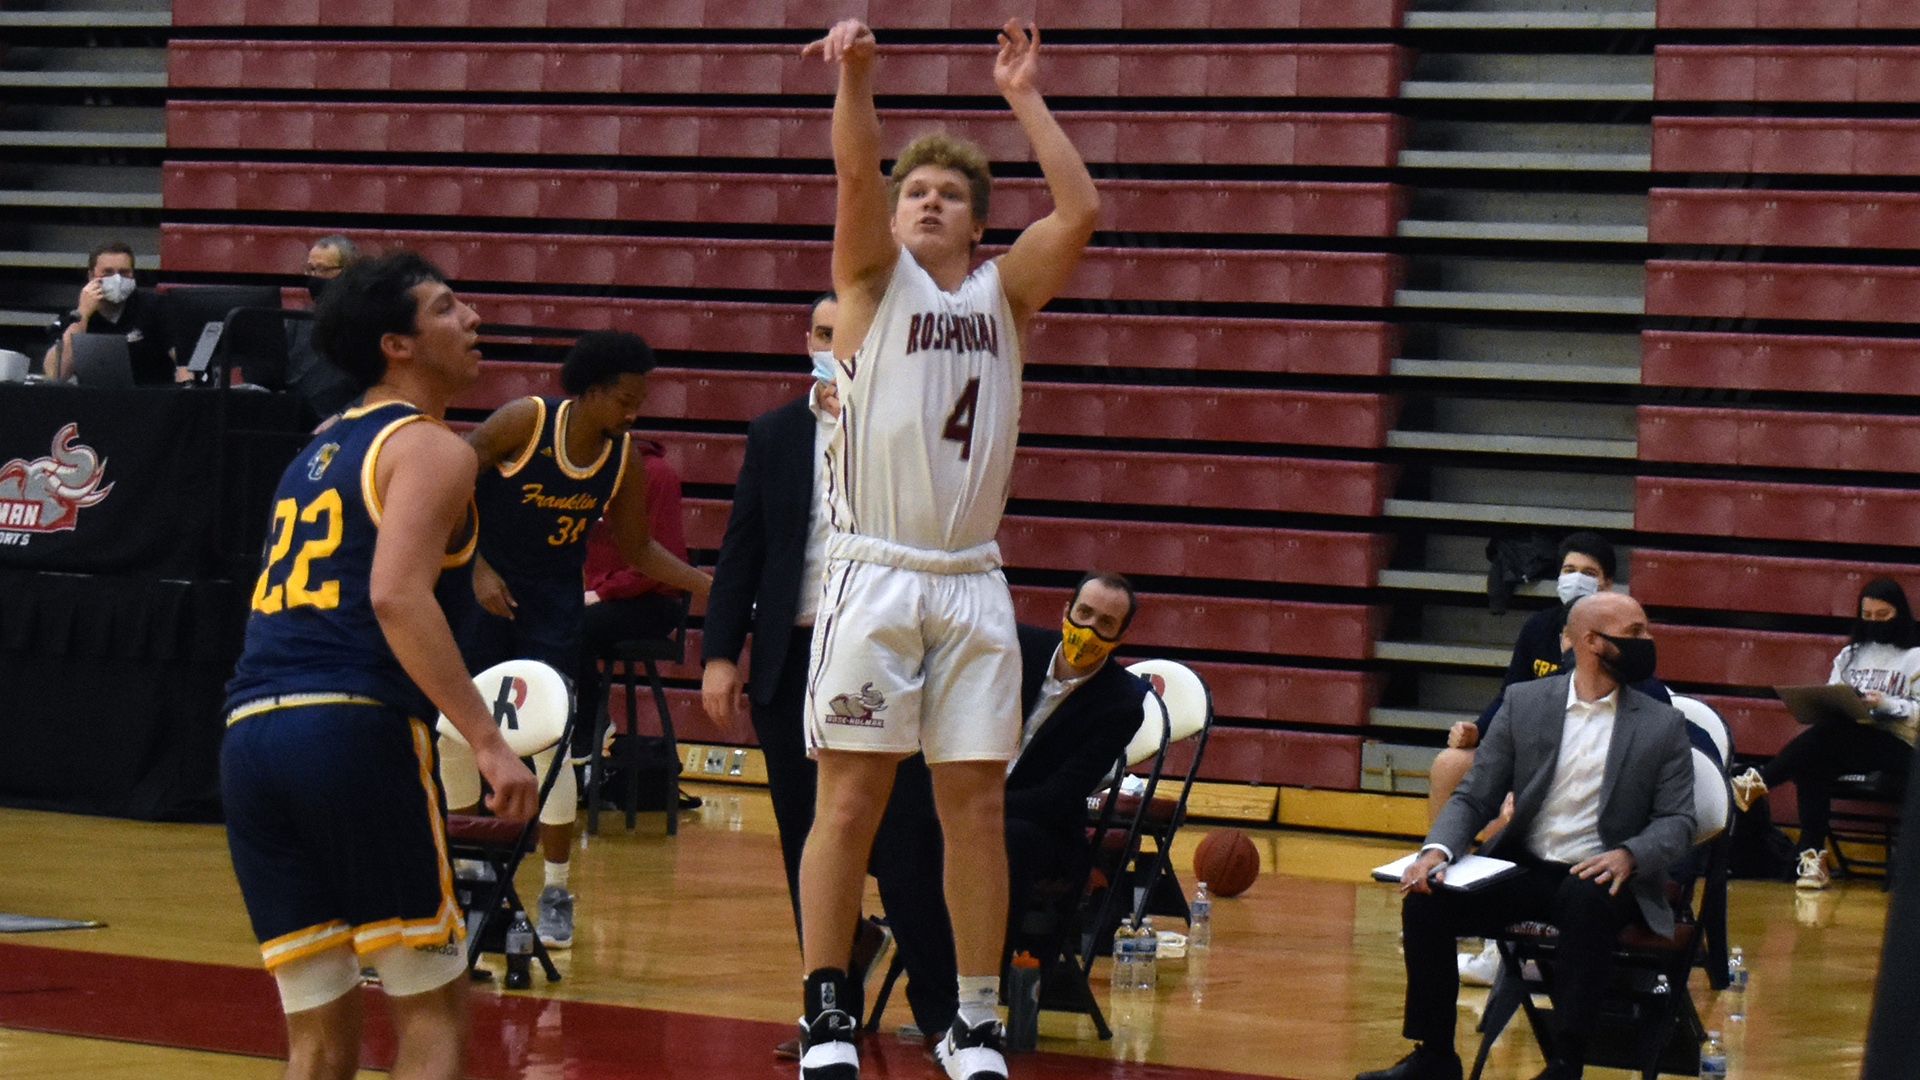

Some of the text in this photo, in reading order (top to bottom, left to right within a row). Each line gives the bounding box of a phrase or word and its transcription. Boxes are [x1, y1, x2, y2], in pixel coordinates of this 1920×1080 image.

[942, 376, 981, 461] 4
[522, 483, 598, 510] Franklin
[252, 488, 343, 615] 22
